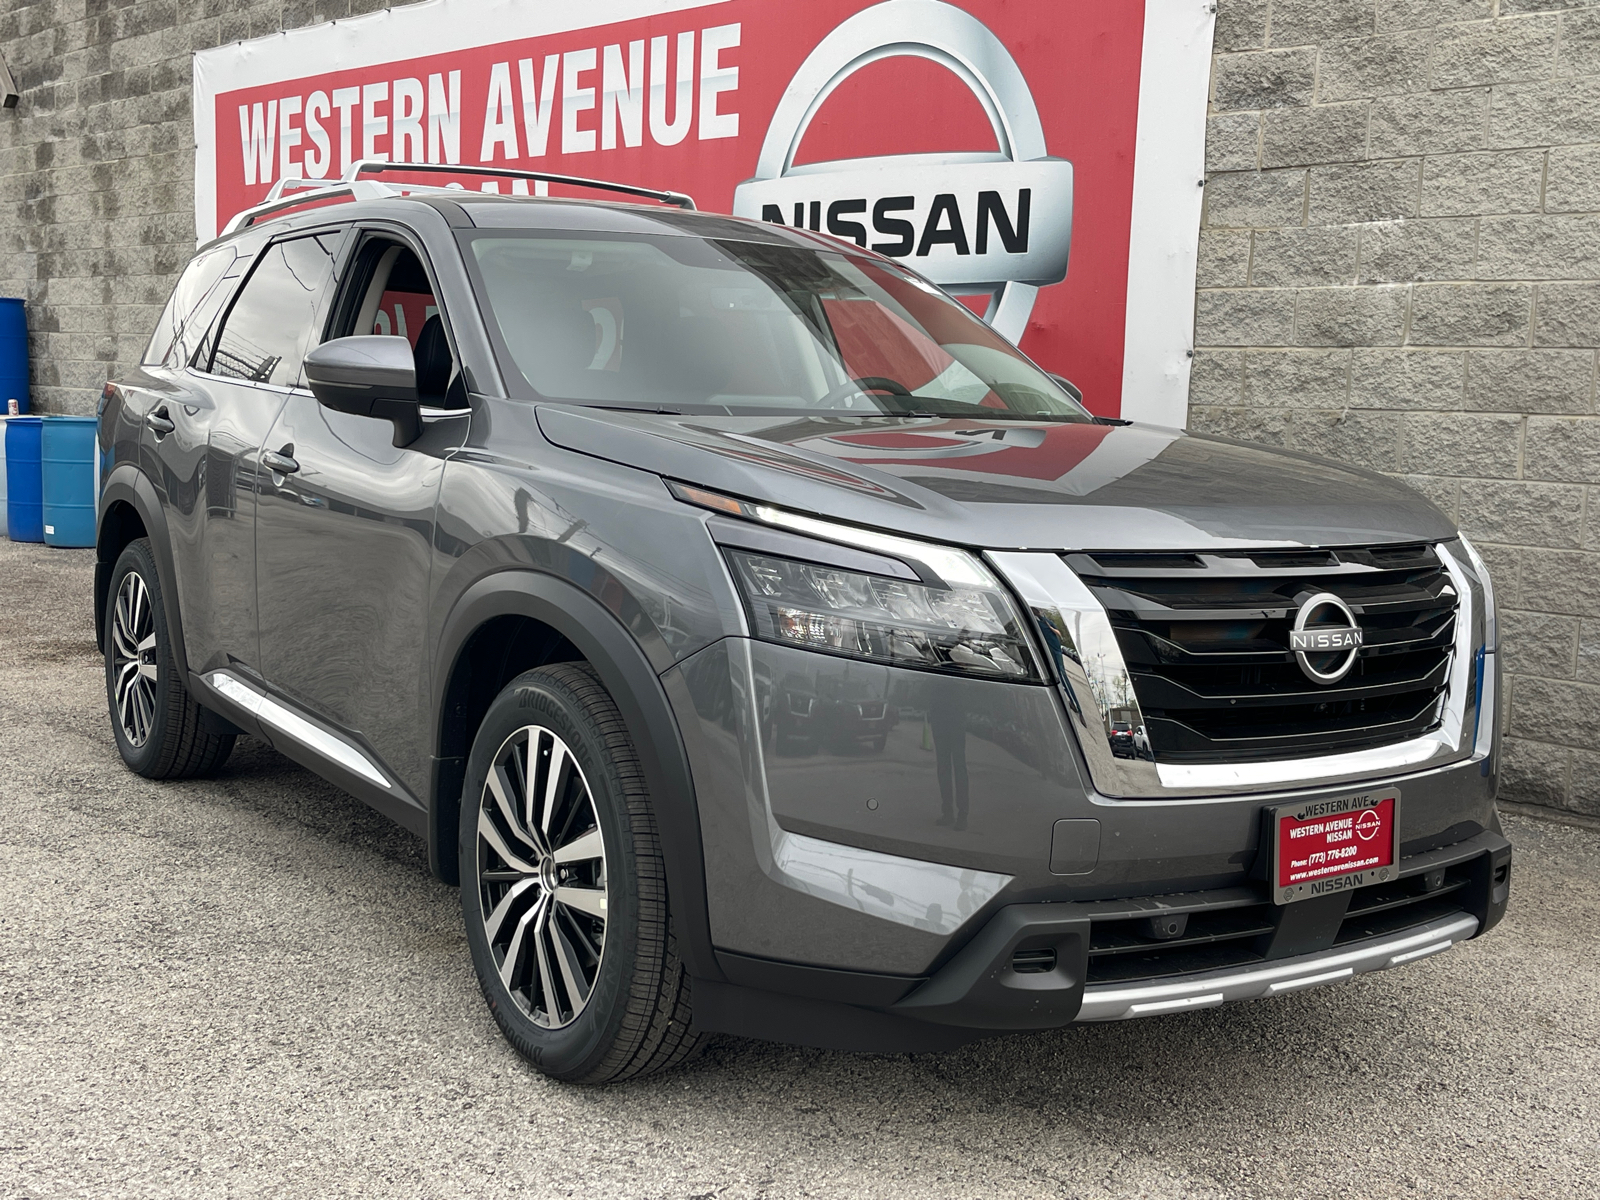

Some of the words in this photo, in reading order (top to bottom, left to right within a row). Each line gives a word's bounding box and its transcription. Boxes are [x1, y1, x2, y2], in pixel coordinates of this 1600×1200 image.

[238, 69, 462, 186] WESTERN
[480, 22, 742, 162] AVENUE
[1293, 632, 1362, 648] NISSAN
[518, 689, 595, 769] BRIDGESTONE
[1305, 799, 1349, 817] WESTERN
[1290, 823, 1324, 839] WESTERN
[1325, 818, 1353, 832] AVENUE
[1355, 820, 1381, 830] NISSAN
[1326, 829, 1353, 843] NISSAN
[1290, 858, 1308, 868] Phone:
[1308, 851, 1326, 867] (773)
[1327, 845, 1358, 861] 776-8200
[1290, 856, 1379, 881] www.westernavenissan.com
[1311, 873, 1363, 895] NISSAN
